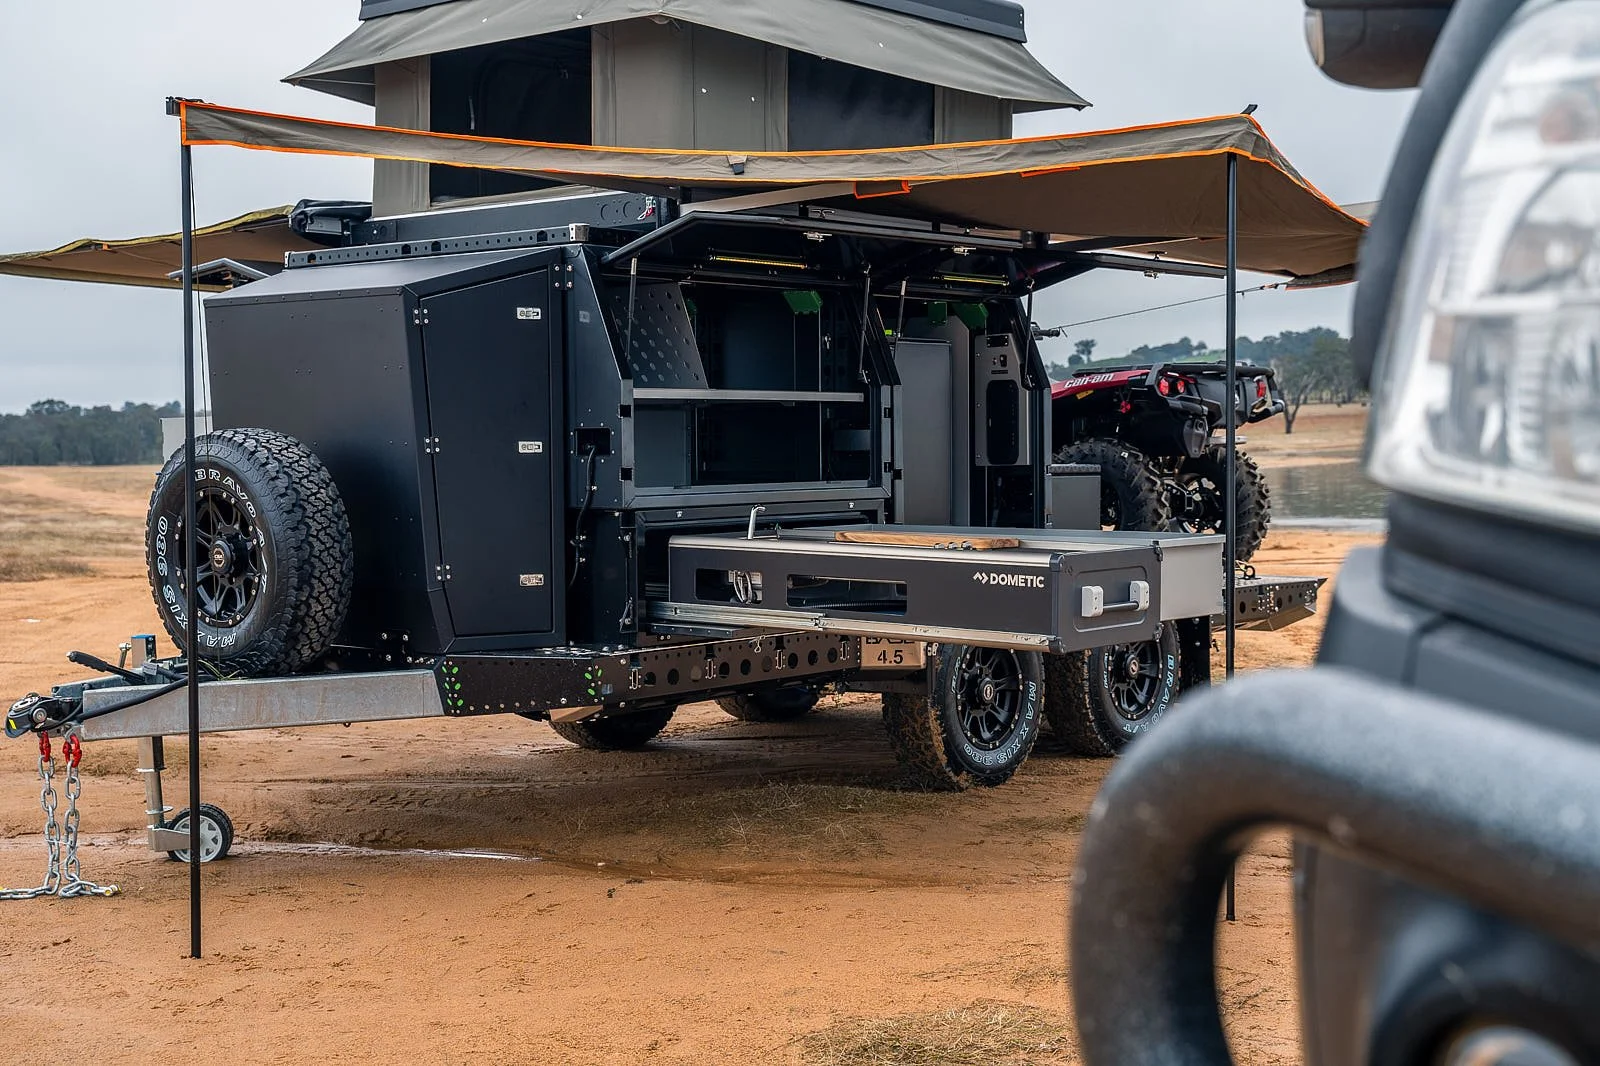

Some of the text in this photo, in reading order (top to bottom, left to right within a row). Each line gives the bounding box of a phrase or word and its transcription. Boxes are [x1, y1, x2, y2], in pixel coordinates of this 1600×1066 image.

[195, 469, 257, 518] BRAVO
[156, 516, 169, 577] 980
[989, 572, 1045, 588] DOMETIC
[877, 649, 904, 664] 4.5
[963, 681, 1037, 766] MAXXIS 980
